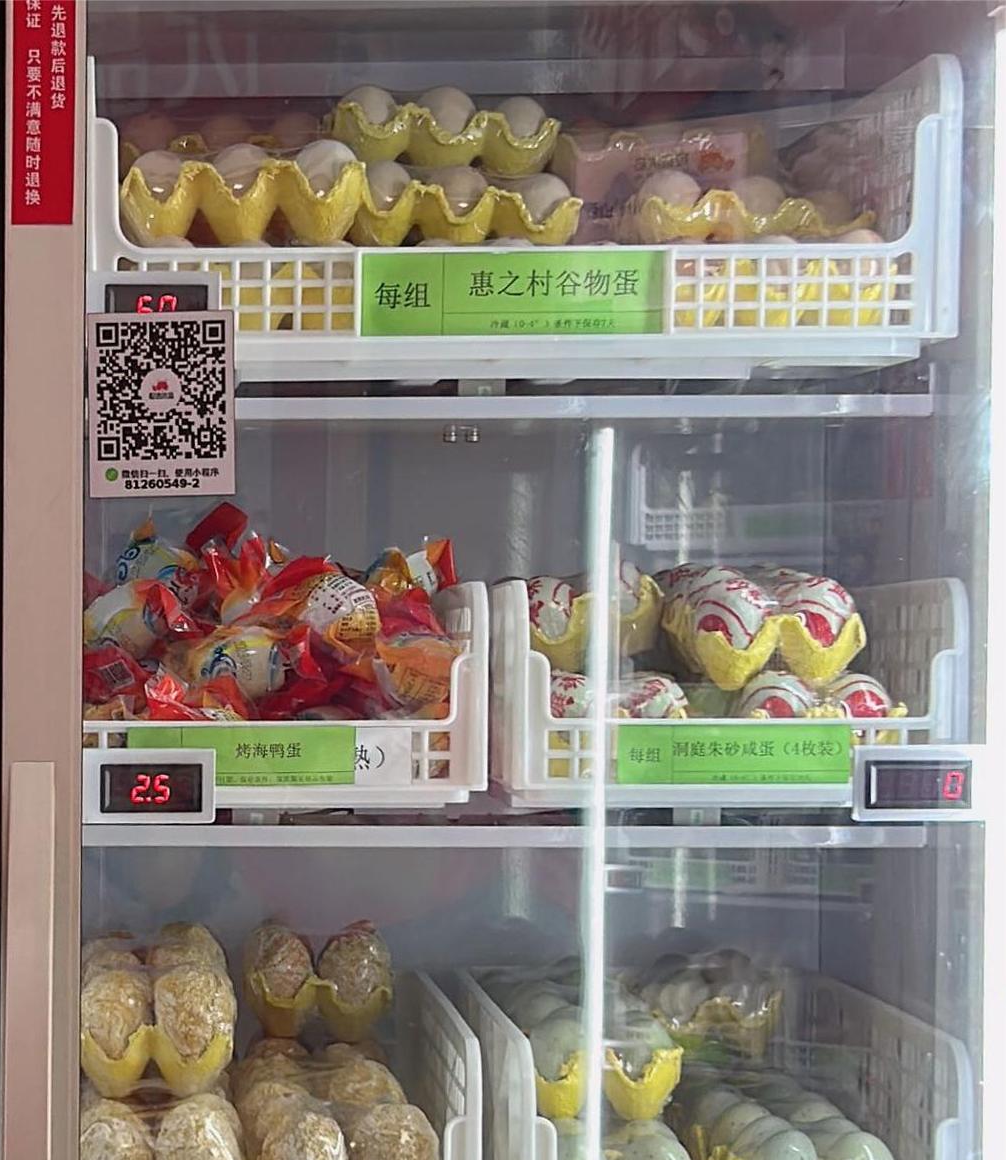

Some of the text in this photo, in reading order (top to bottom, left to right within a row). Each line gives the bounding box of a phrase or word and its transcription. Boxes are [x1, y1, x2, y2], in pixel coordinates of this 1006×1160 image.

[50, 5, 67, 109] 先退款后退货
[25, 49, 42, 205] 只要不满意随时退换
[374, 281, 431, 309] 每组
[468, 269, 640, 297] 惠之村谷物蛋
[124, 478, 200, 490] 81260549-2
[235, 742, 302, 760] 烤海鸭蛋
[130, 774, 171, 805] 2.5
[942, 770, 965, 800] 0
